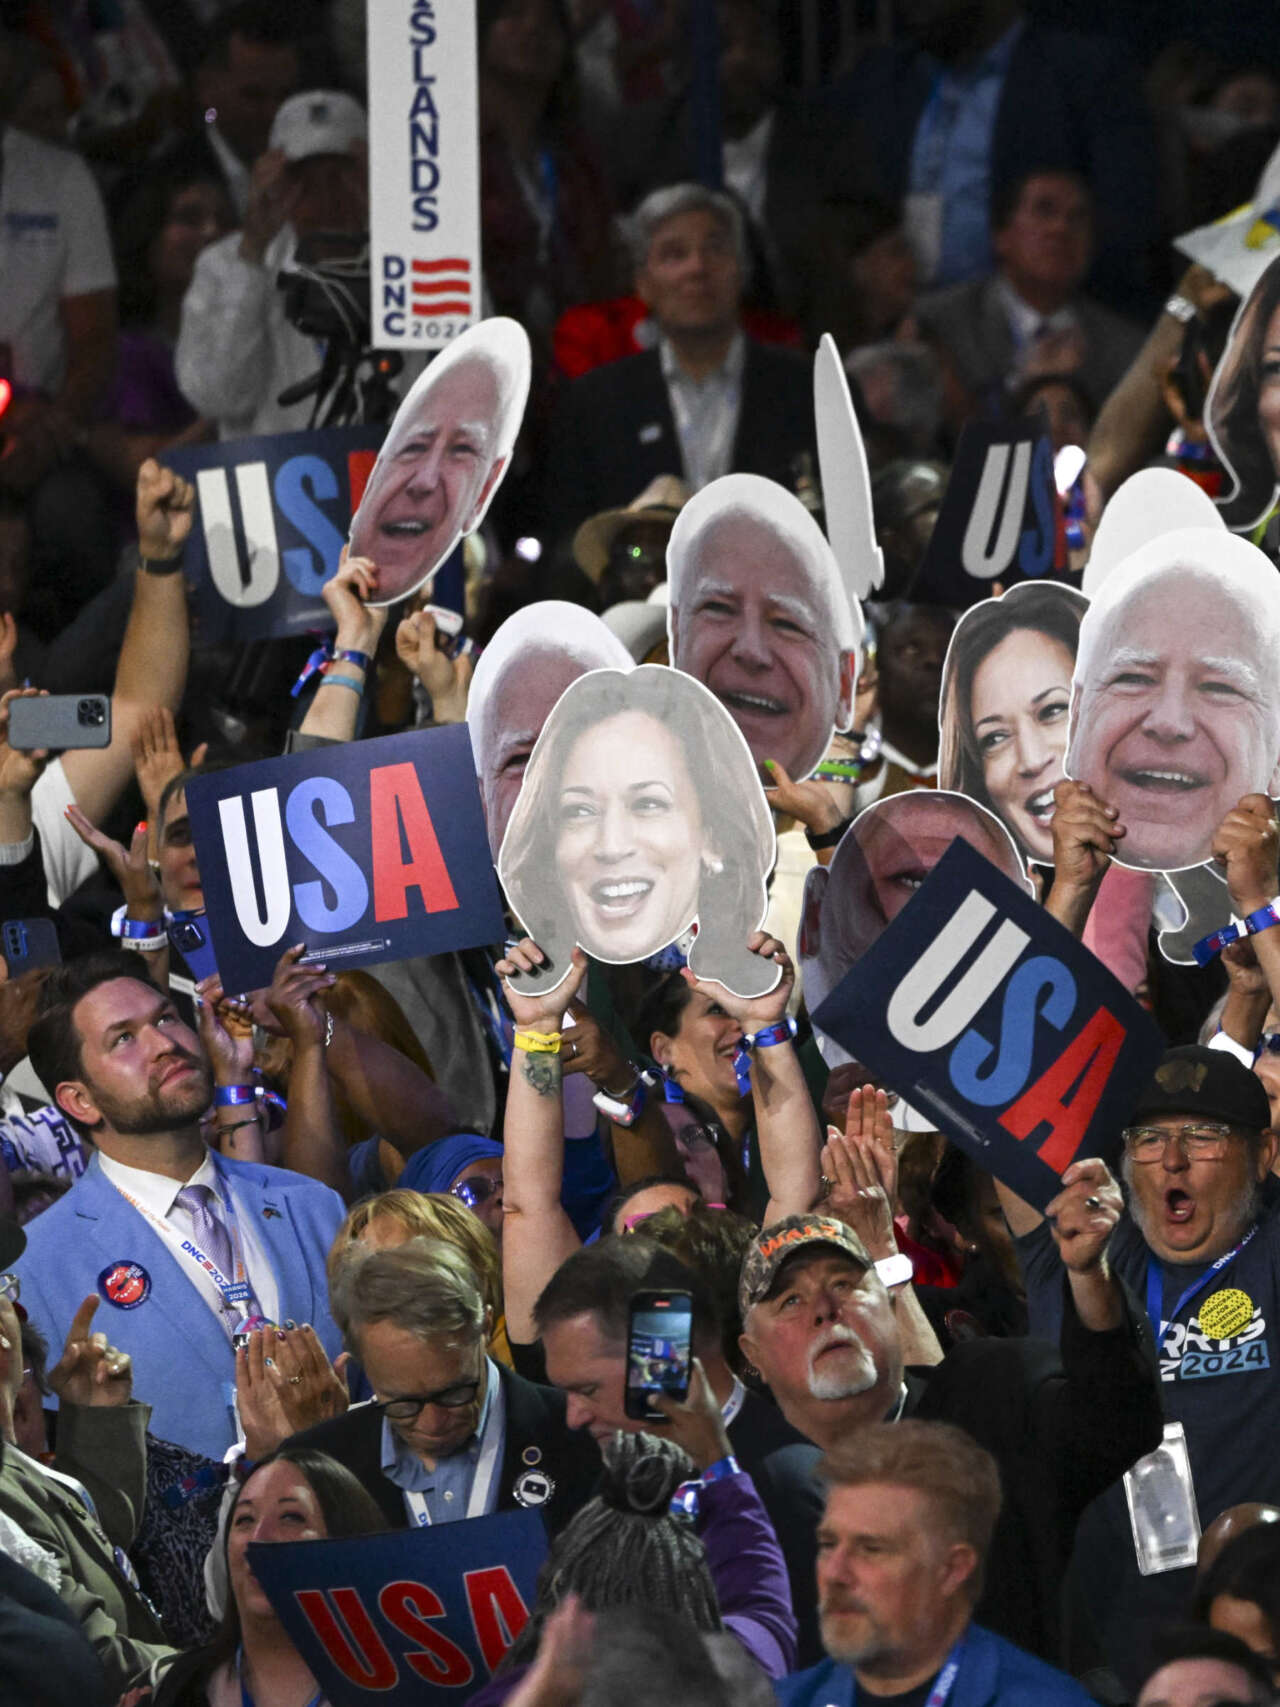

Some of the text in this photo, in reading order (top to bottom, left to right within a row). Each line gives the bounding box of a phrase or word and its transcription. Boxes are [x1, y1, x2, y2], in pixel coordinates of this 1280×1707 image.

[409, 0, 440, 233] SLANDS
[382, 254, 407, 338] DNC
[217, 761, 460, 948] USA
[886, 888, 1127, 1176] USA
[180, 1240, 230, 1288] DNC 202
[1182, 1343, 1266, 1377] 2024
[294, 1565, 531, 1692] USA
